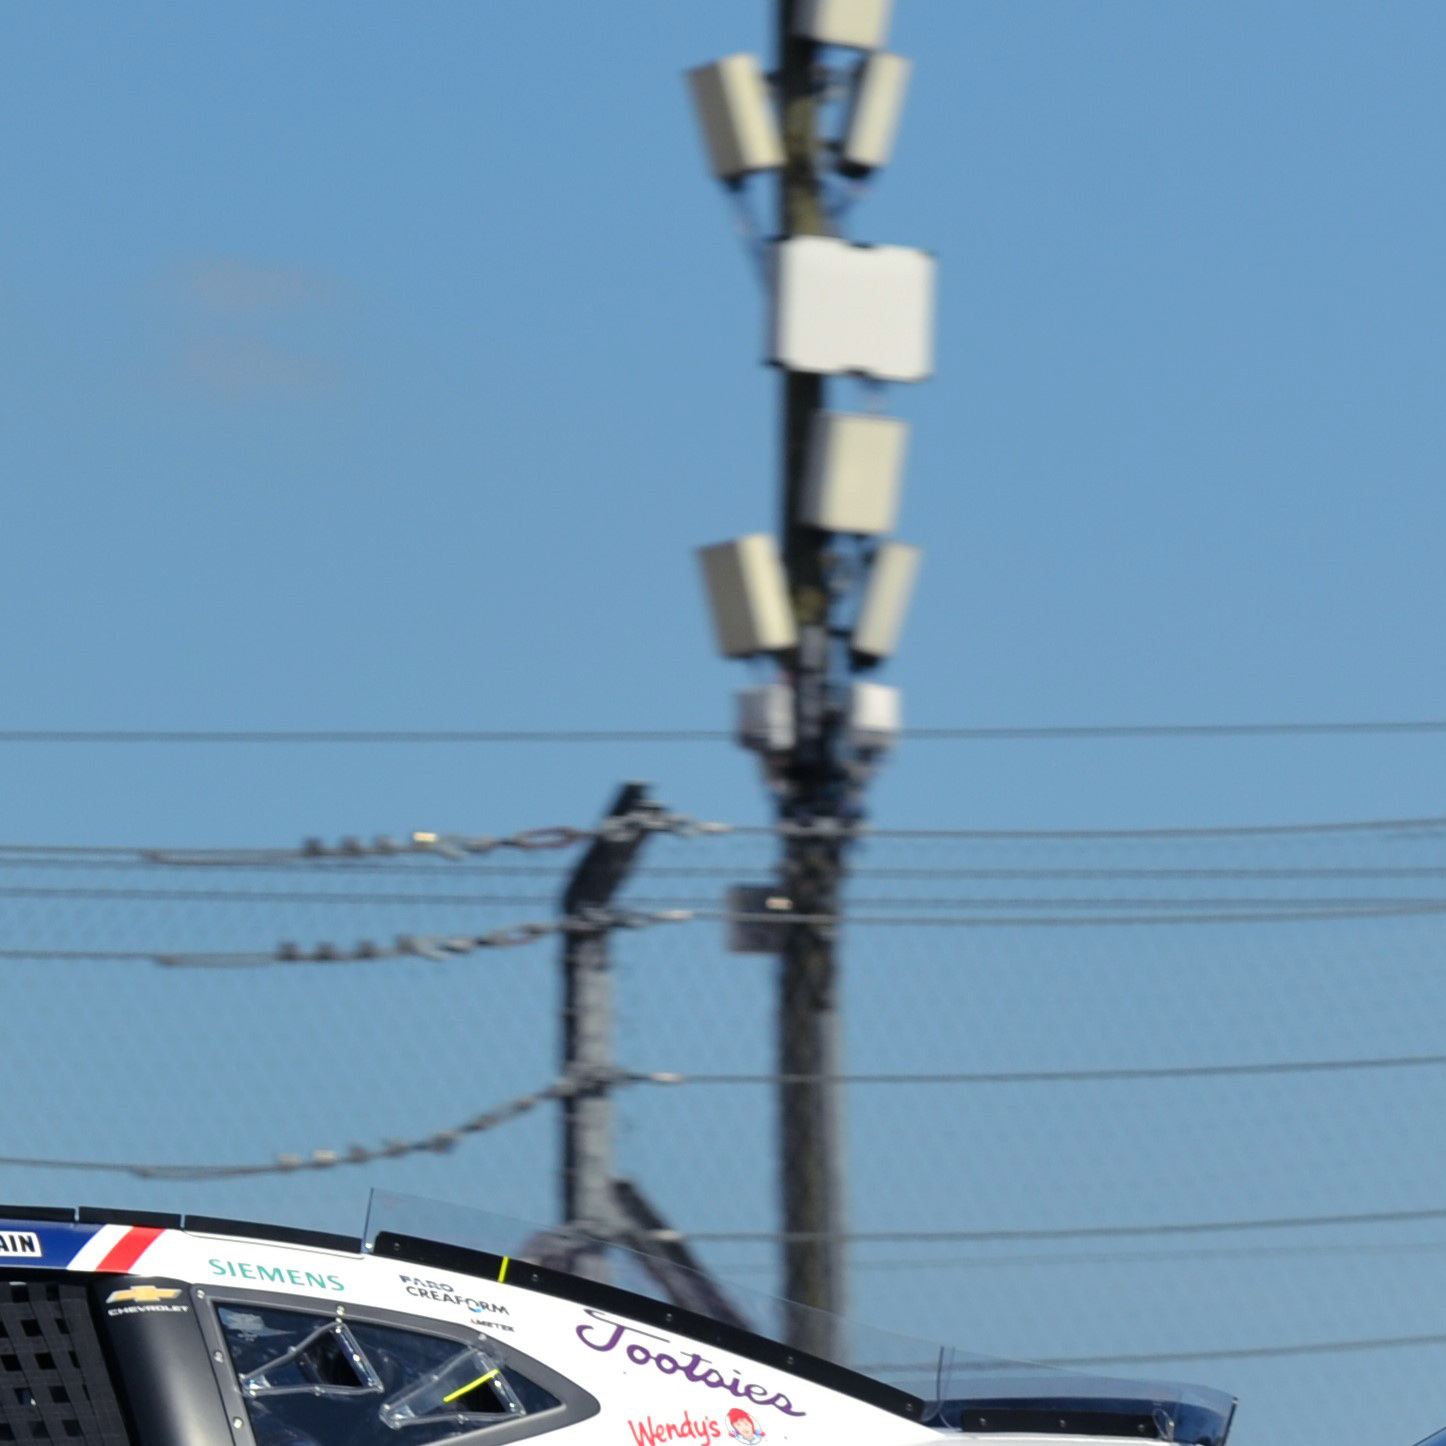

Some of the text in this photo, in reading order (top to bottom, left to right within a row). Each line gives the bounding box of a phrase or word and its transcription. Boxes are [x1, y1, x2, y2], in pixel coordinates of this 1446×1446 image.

[208, 1258, 346, 1292] SIEMENS
[107, 1304, 190, 1317] CHEVROLET
[405, 1285, 511, 1316] CREAFORM
[575, 1308, 807, 1417] Tootsies
